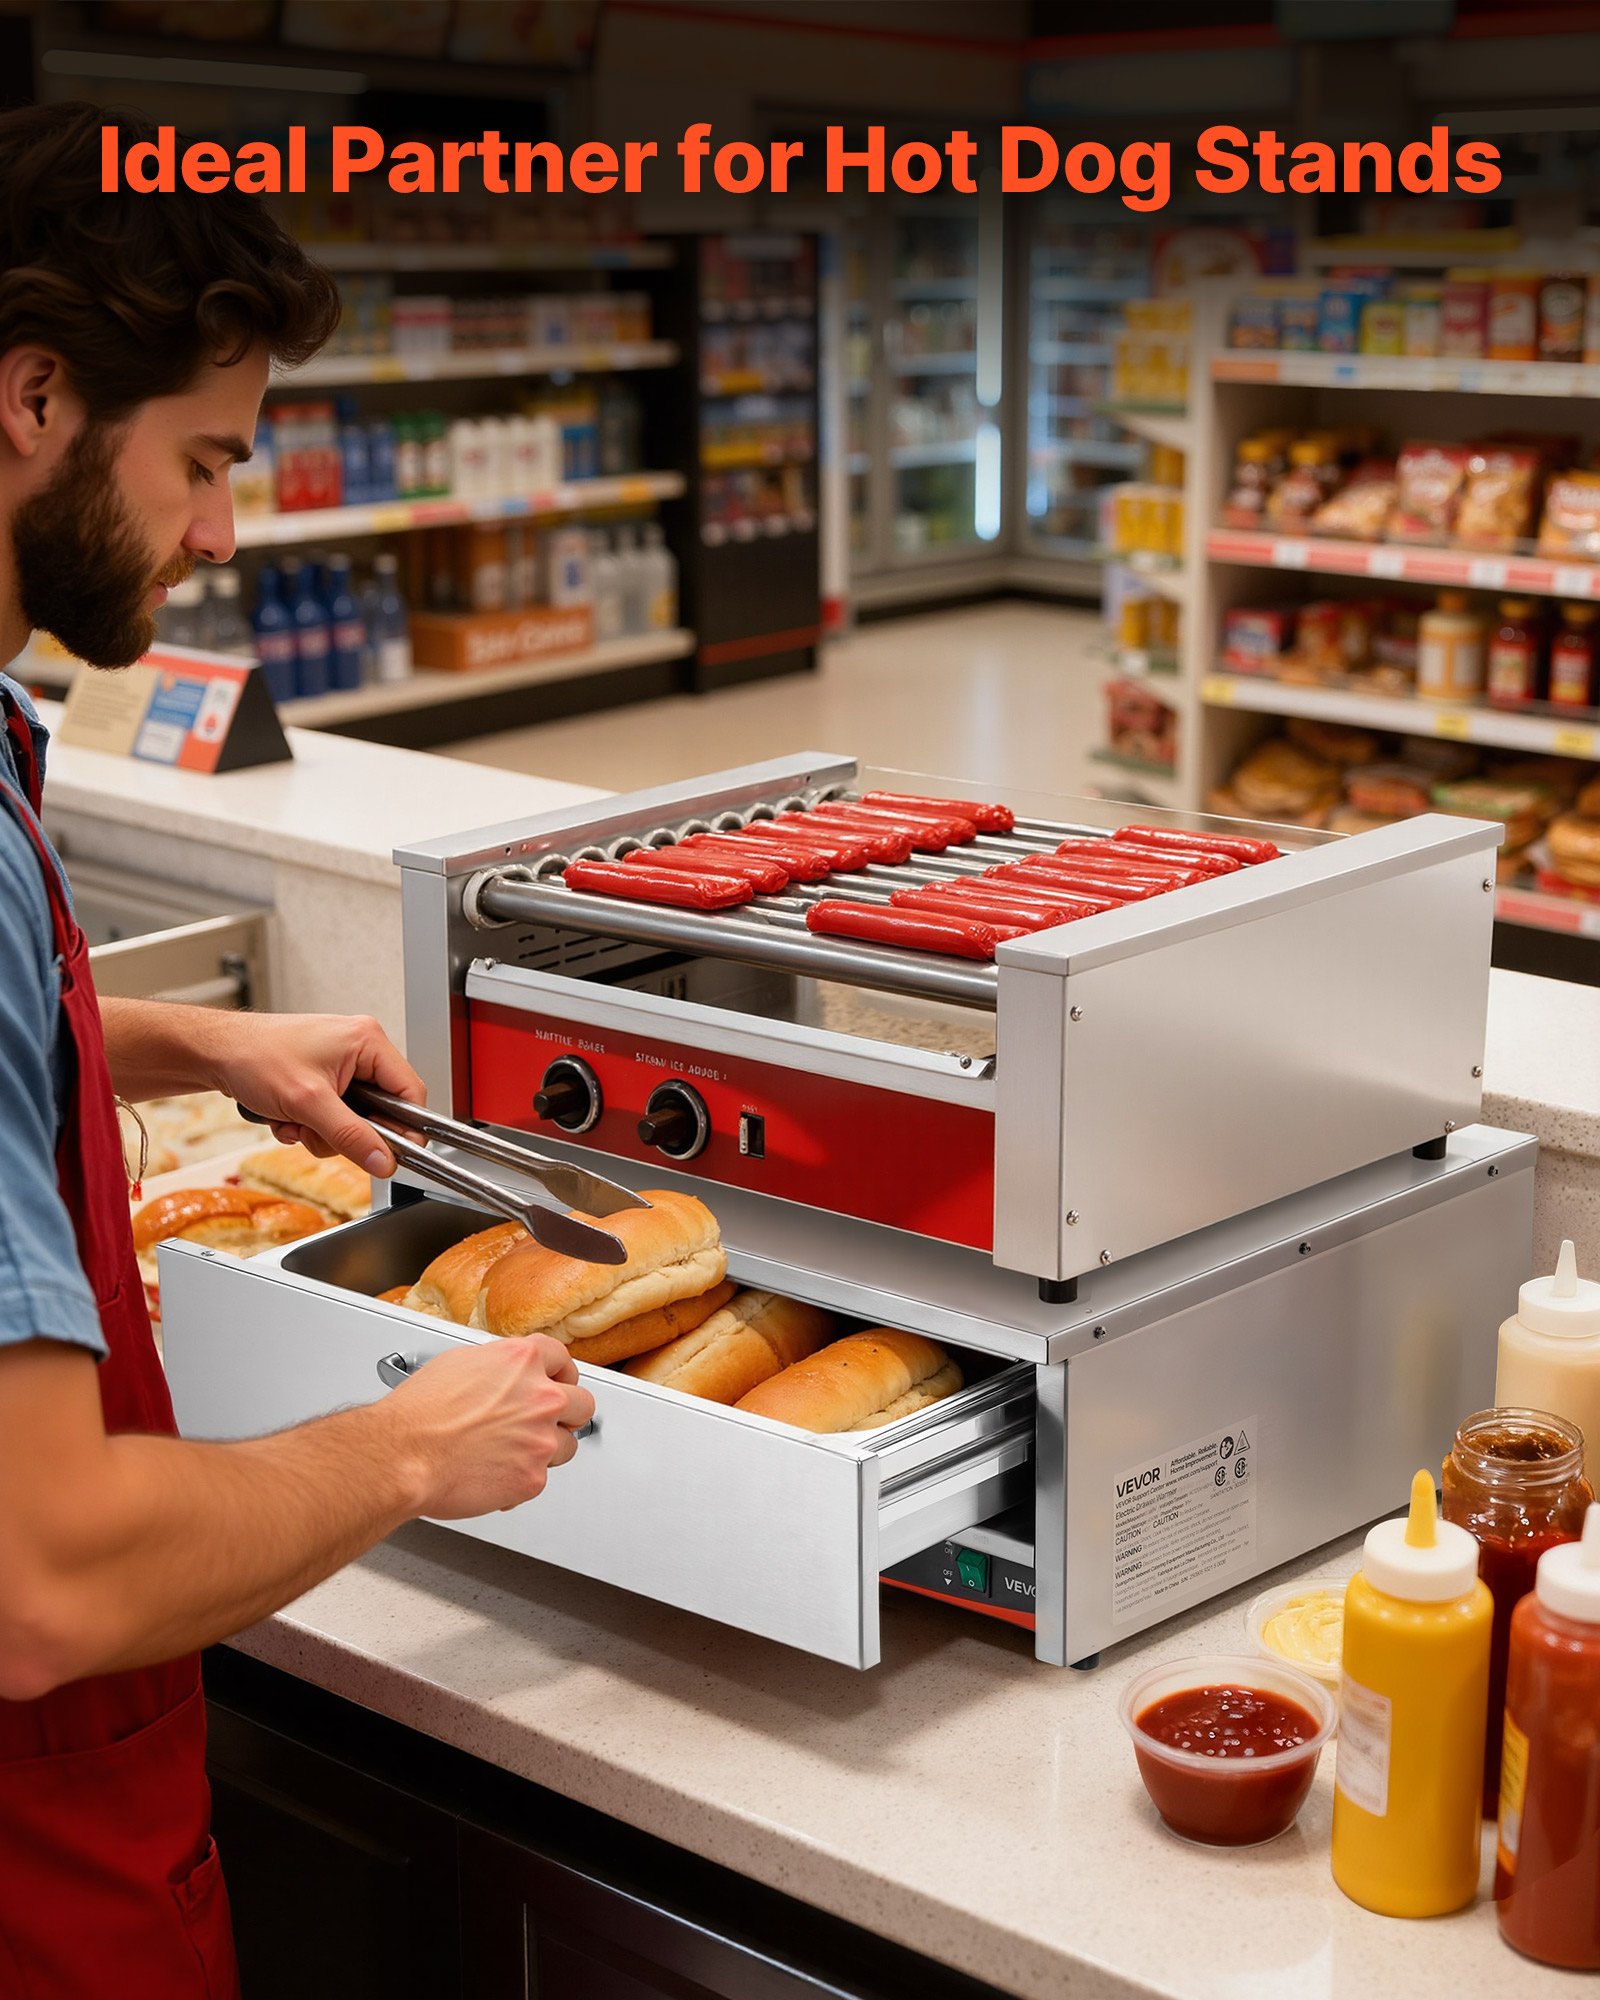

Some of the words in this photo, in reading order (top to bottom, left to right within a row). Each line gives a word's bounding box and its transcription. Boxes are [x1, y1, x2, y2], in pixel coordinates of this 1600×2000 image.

[1170, 1465, 1184, 1475] Home
[1116, 1467, 1160, 1498] VEVOR
[1116, 1498, 1131, 1509] VEVOR
[1132, 1490, 1150, 1503] Support
[1150, 1483, 1164, 1494] Center
[1116, 1506, 1135, 1520] Electric
[1115, 1529, 1141, 1546] CAUTION
[1153, 1512, 1178, 1529] CAUTION
[1114, 1545, 1142, 1563] WARNING
[1114, 1562, 1142, 1580] WARNING
